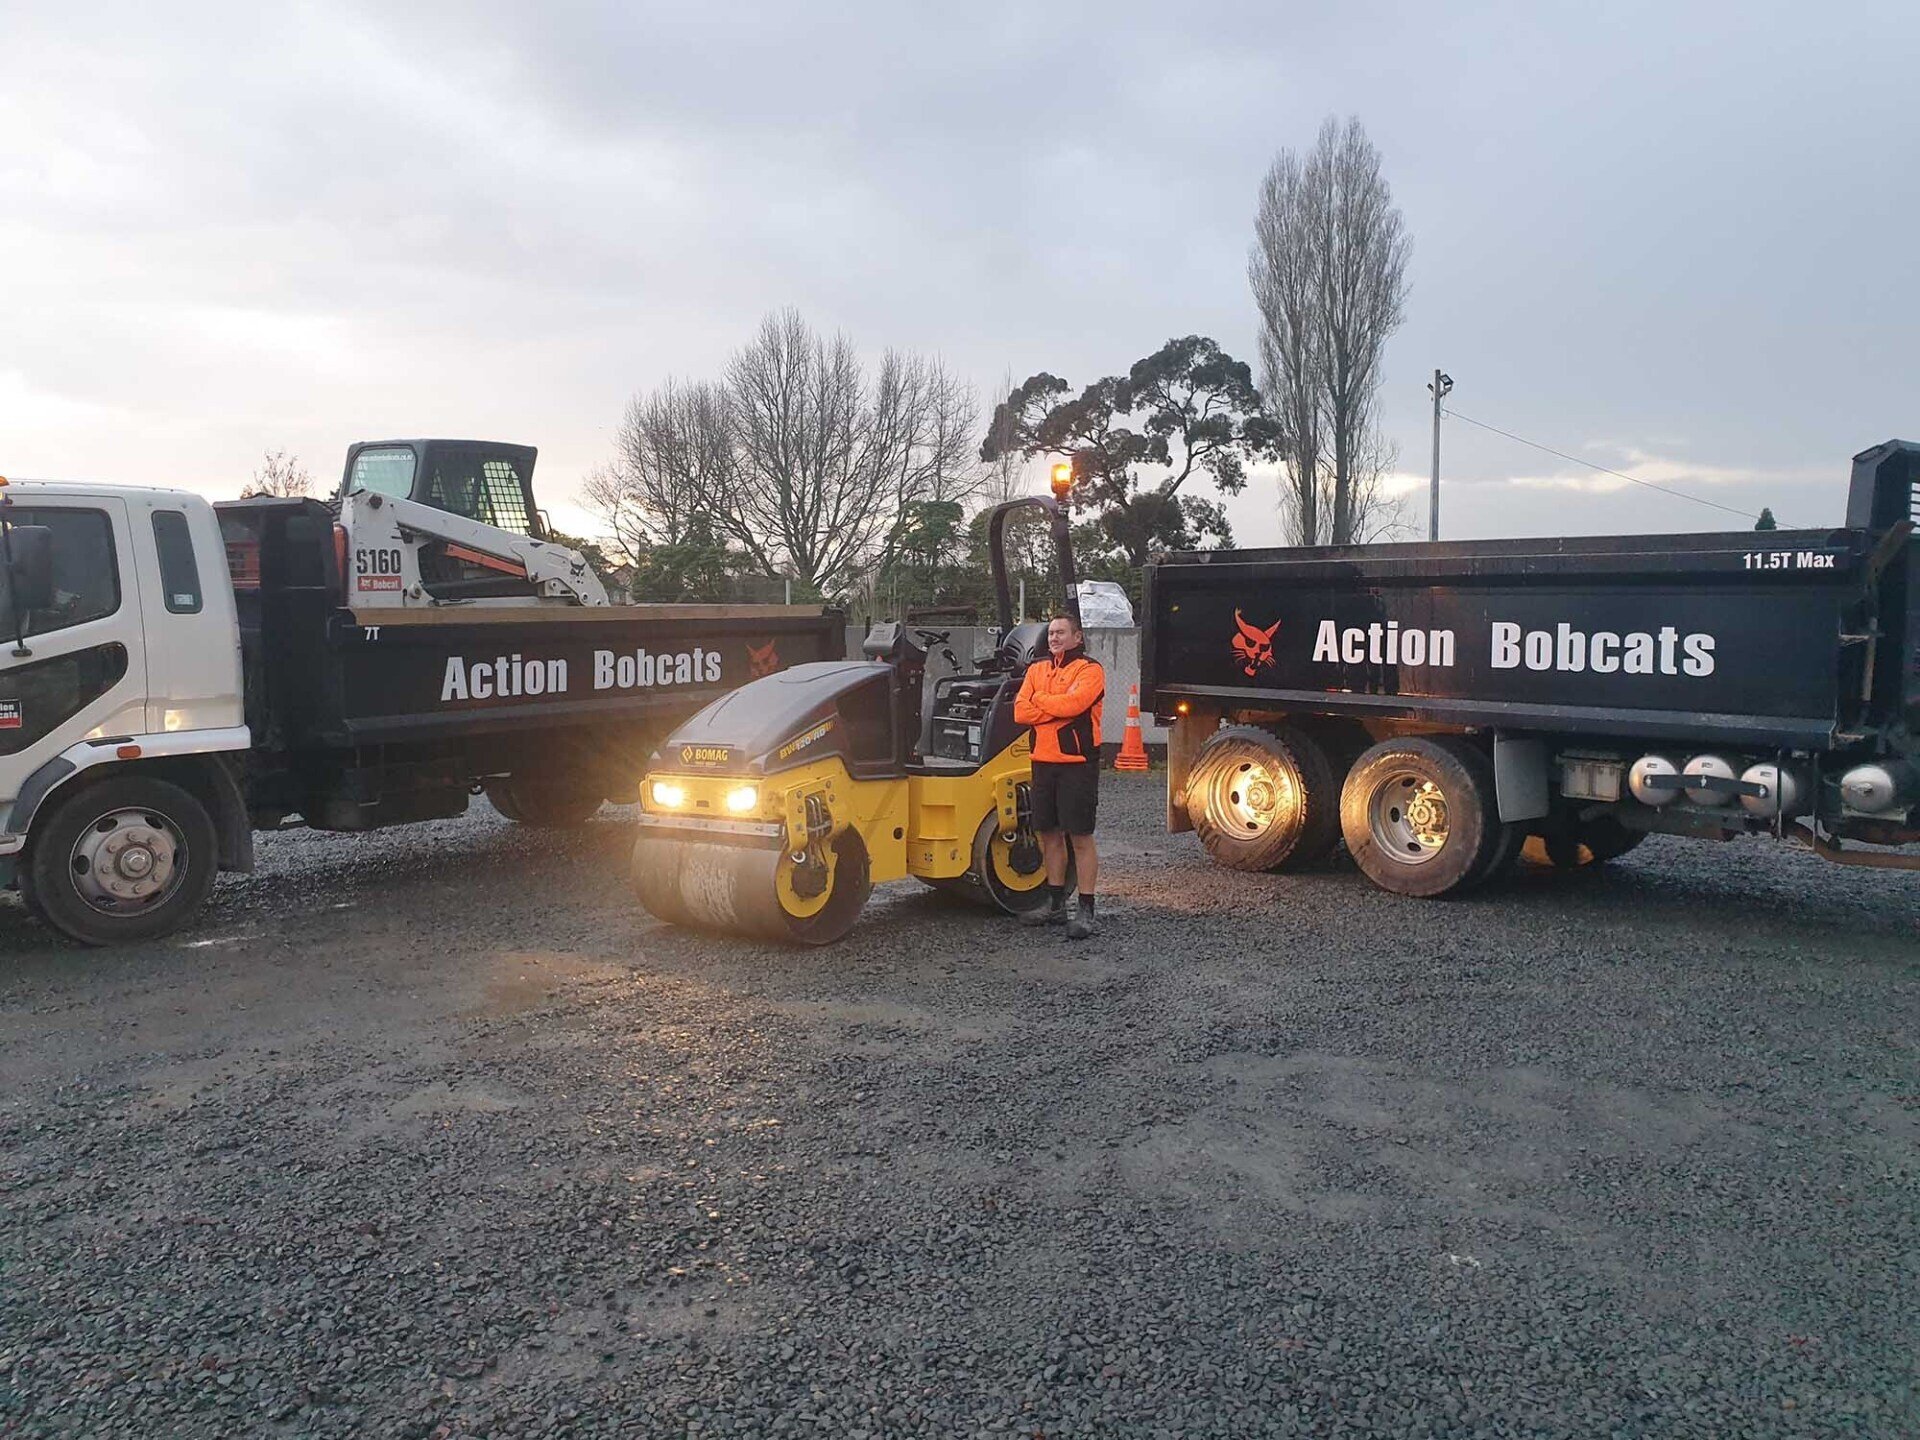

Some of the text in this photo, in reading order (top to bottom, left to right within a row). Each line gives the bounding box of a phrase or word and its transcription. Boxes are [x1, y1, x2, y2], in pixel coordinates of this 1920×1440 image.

[356, 549, 401, 574] S160
[1743, 552, 1835, 569] 11.5T Max
[373, 579, 399, 590] Bobcat
[364, 626, 380, 640] 7T
[1312, 620, 1716, 677] Action Bobcats
[440, 648, 722, 701] Action Bobcats
[695, 749, 728, 761] BOMAG
